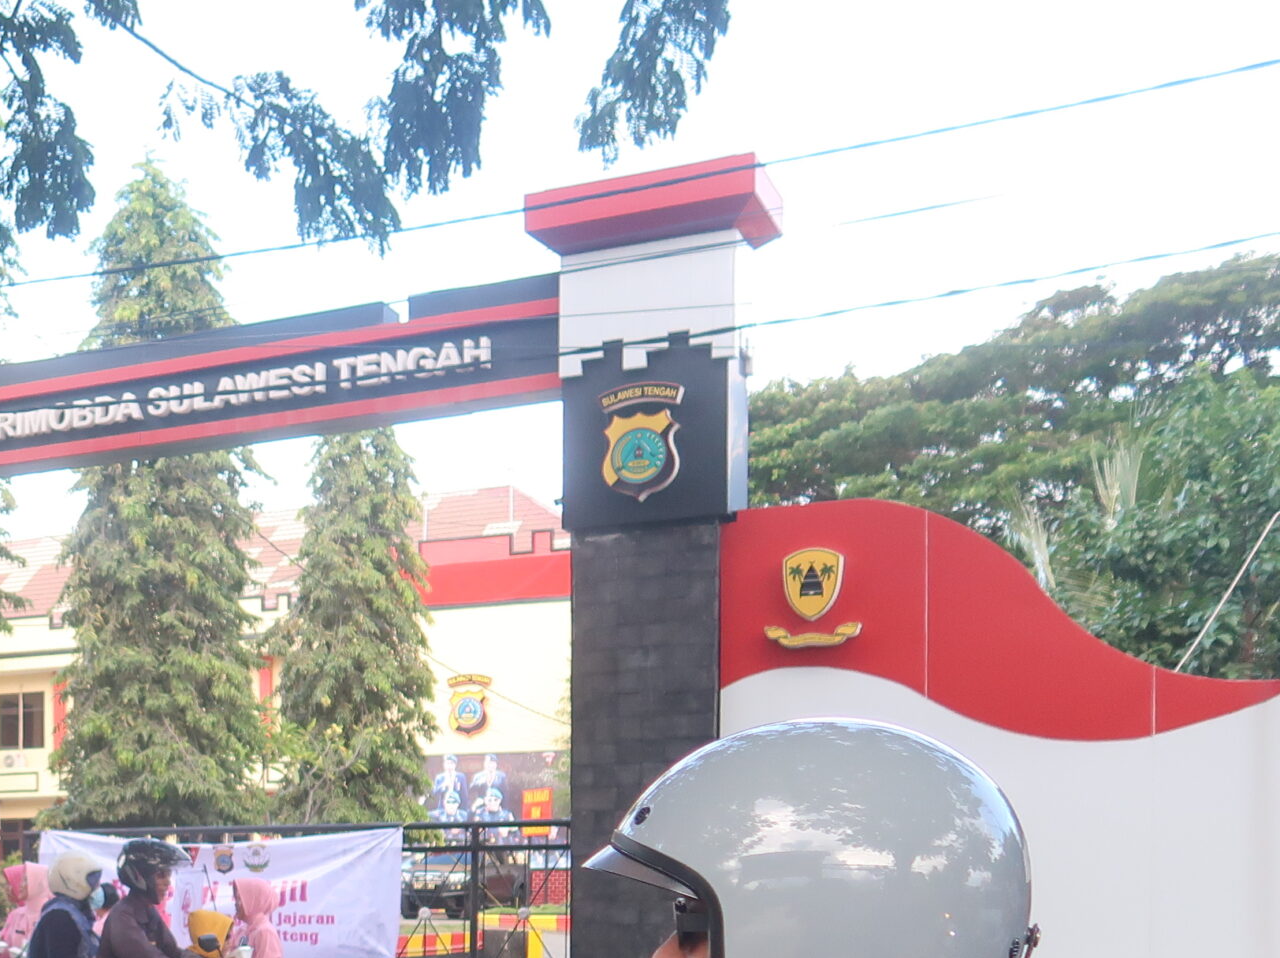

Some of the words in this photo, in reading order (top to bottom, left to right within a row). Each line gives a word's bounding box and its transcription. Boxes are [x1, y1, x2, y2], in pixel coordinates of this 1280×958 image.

[147, 362, 327, 418] SULAWESI
[332, 336, 492, 390] TENGAH
[602, 387, 642, 407] SULAWESI
[643, 386, 677, 398] TENGAH
